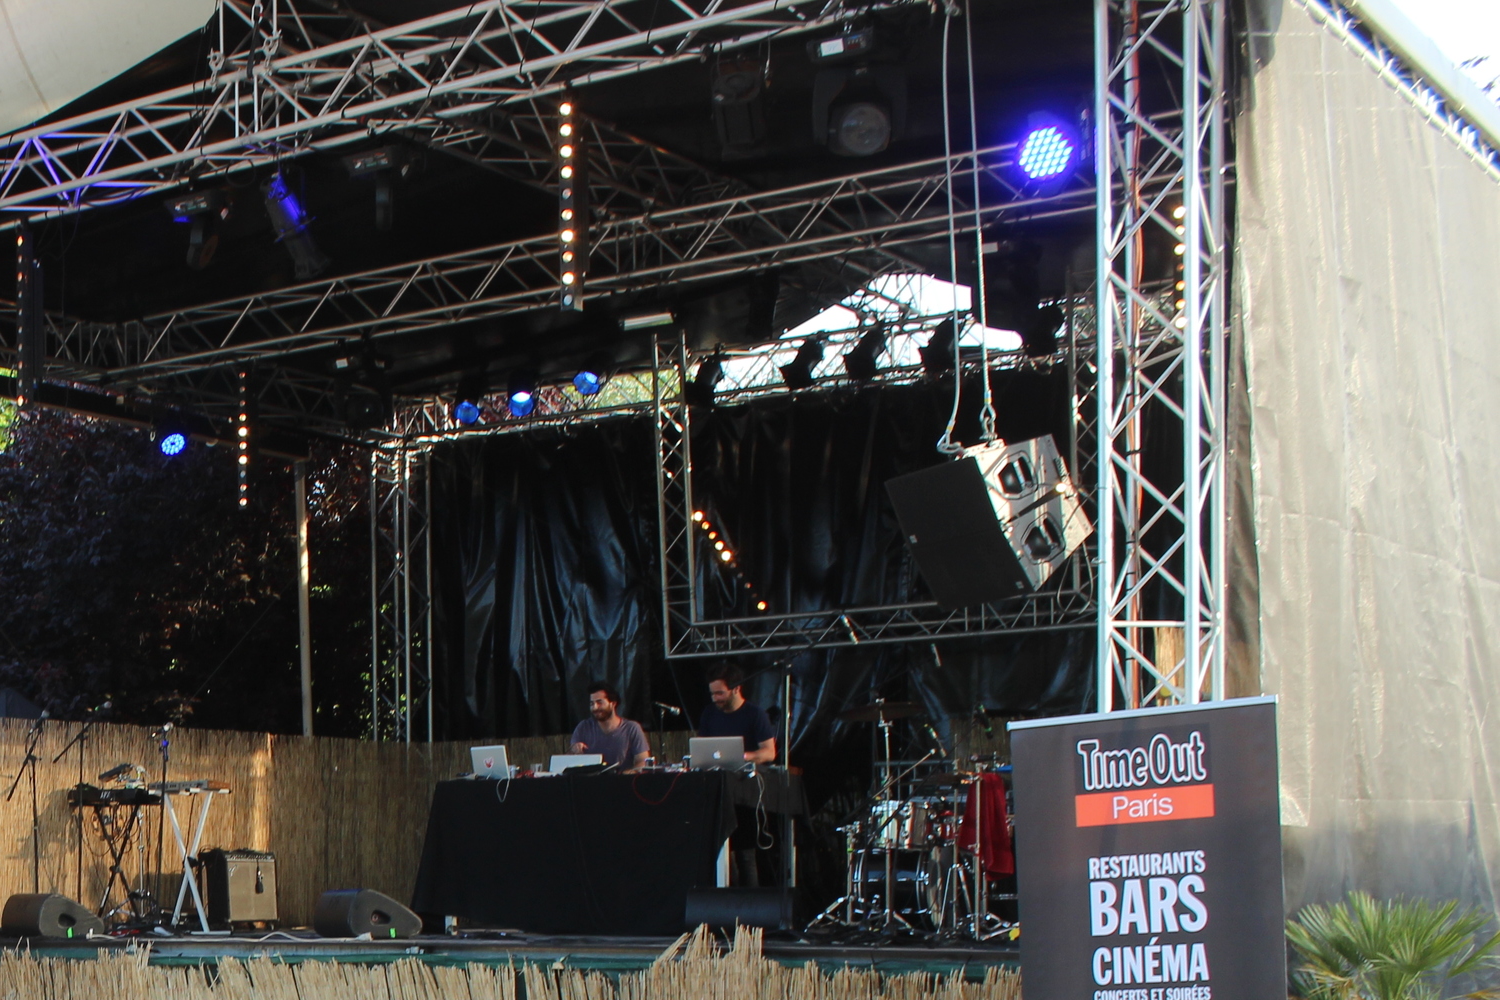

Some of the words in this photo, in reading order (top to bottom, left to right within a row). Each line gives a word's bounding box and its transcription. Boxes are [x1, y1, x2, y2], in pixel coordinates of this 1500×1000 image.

[1076, 738, 1149, 791] Time
[1149, 730, 1207, 785] Out
[1112, 792, 1174, 819] Paris
[1088, 850, 1206, 879] RESTAURANTS
[1089, 874, 1208, 937] BARS
[1092, 936, 1210, 986] CINÉMA
